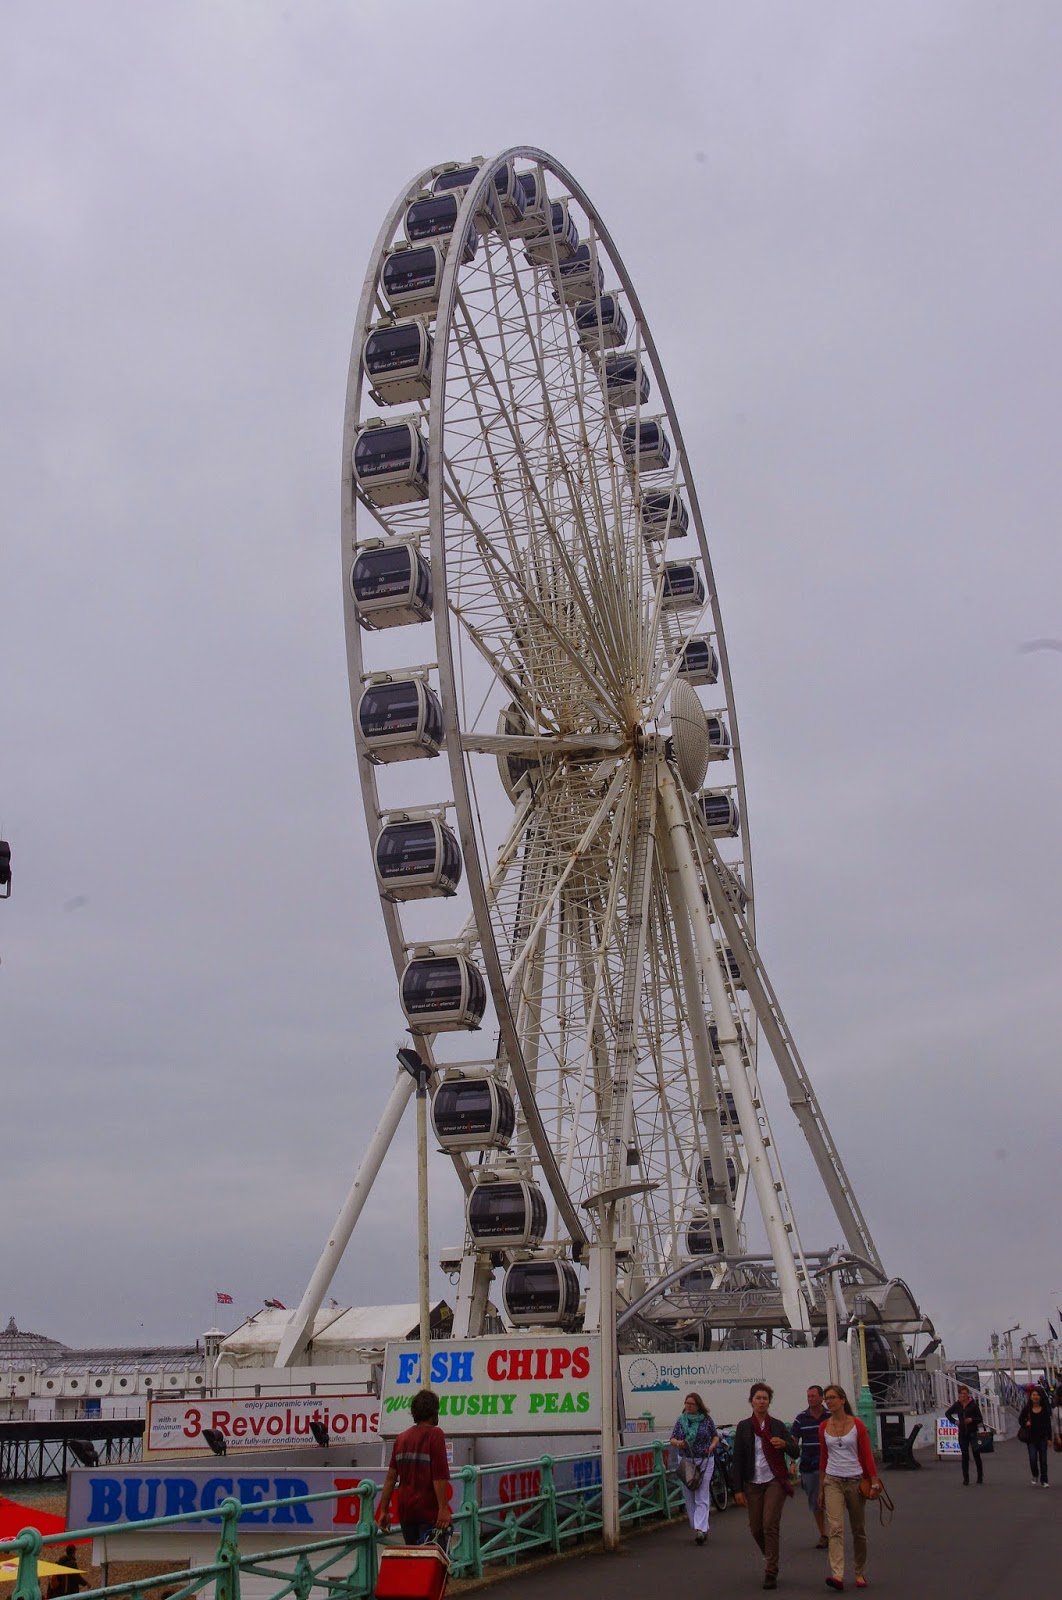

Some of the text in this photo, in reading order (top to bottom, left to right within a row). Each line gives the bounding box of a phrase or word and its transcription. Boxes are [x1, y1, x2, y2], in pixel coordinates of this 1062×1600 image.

[487, 1346, 590, 1382] CHIPS
[723, 1377, 742, 1385] Brighton
[245, 1398, 323, 1410] enjoy panoramic views
[383, 1394, 414, 1413] Wit
[528, 1392, 590, 1413] PEAS
[158, 1415, 171, 1424] with
[183, 1408, 202, 1438] 3
[153, 1423, 181, 1431] minimum
[939, 1428, 960, 1436] CHIP
[244, 1437, 271, 1446] fully-air
[272, 1435, 314, 1444] conditioned
[87, 1477, 315, 1525] BURGER
[499, 1470, 543, 1521] SLUS
